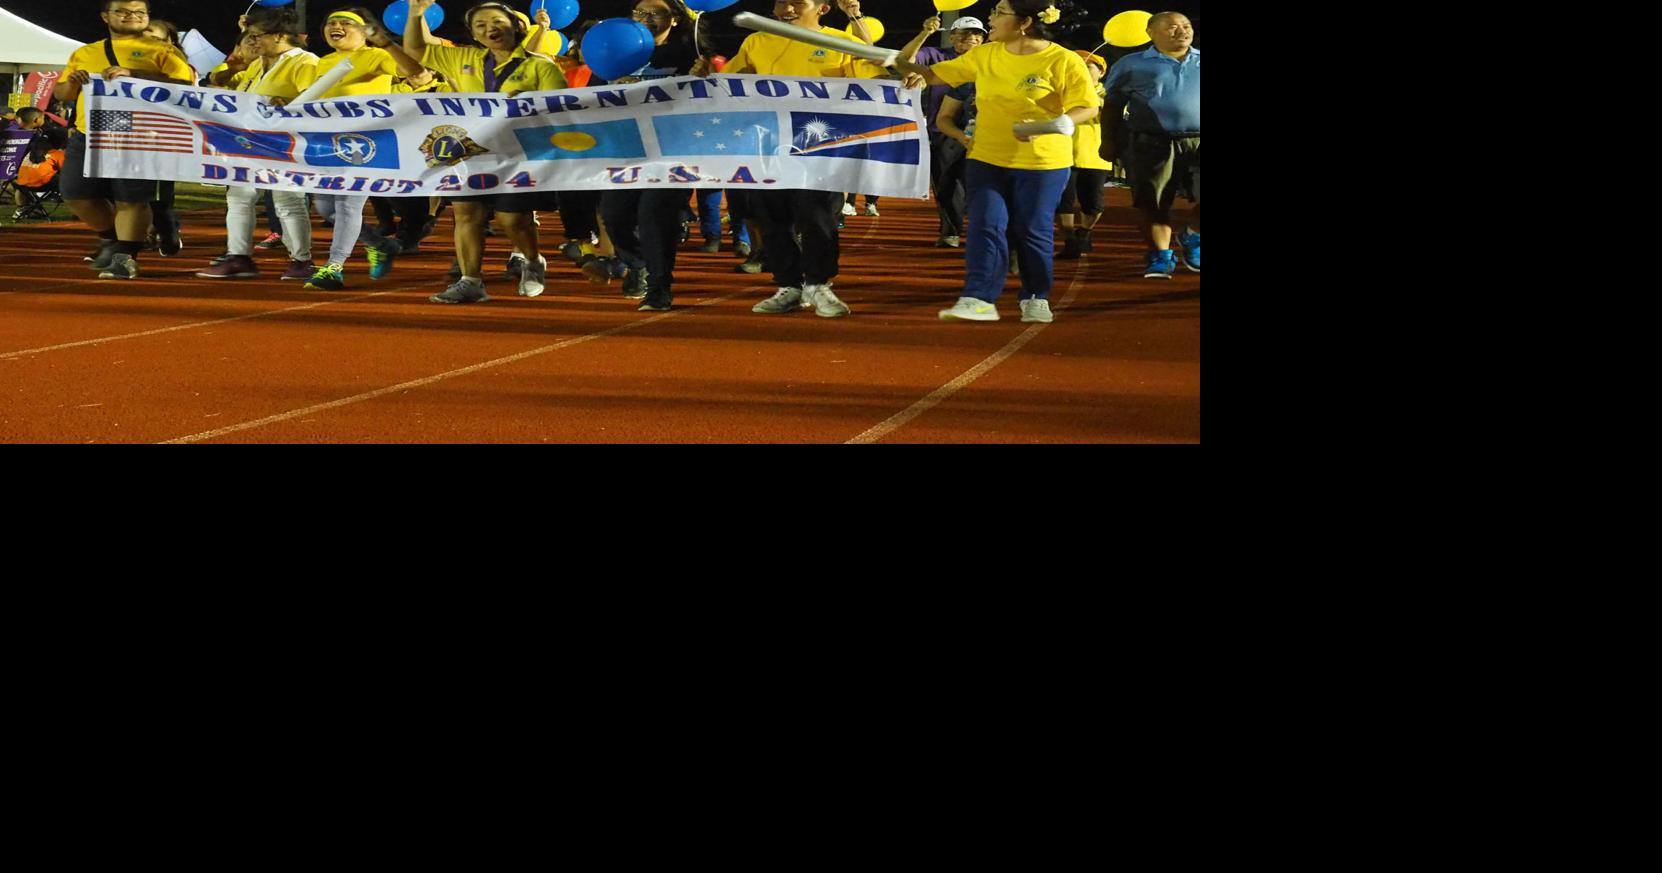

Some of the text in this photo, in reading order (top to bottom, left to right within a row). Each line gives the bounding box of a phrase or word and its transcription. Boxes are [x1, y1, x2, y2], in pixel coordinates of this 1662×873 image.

[91, 79, 238, 113] LIONS
[256, 98, 394, 118] CLUBS
[412, 78, 913, 118] INTERNATIONAL
[438, 140, 452, 157] L
[201, 163, 776, 194] DISTRICT 204 U.S.A.
